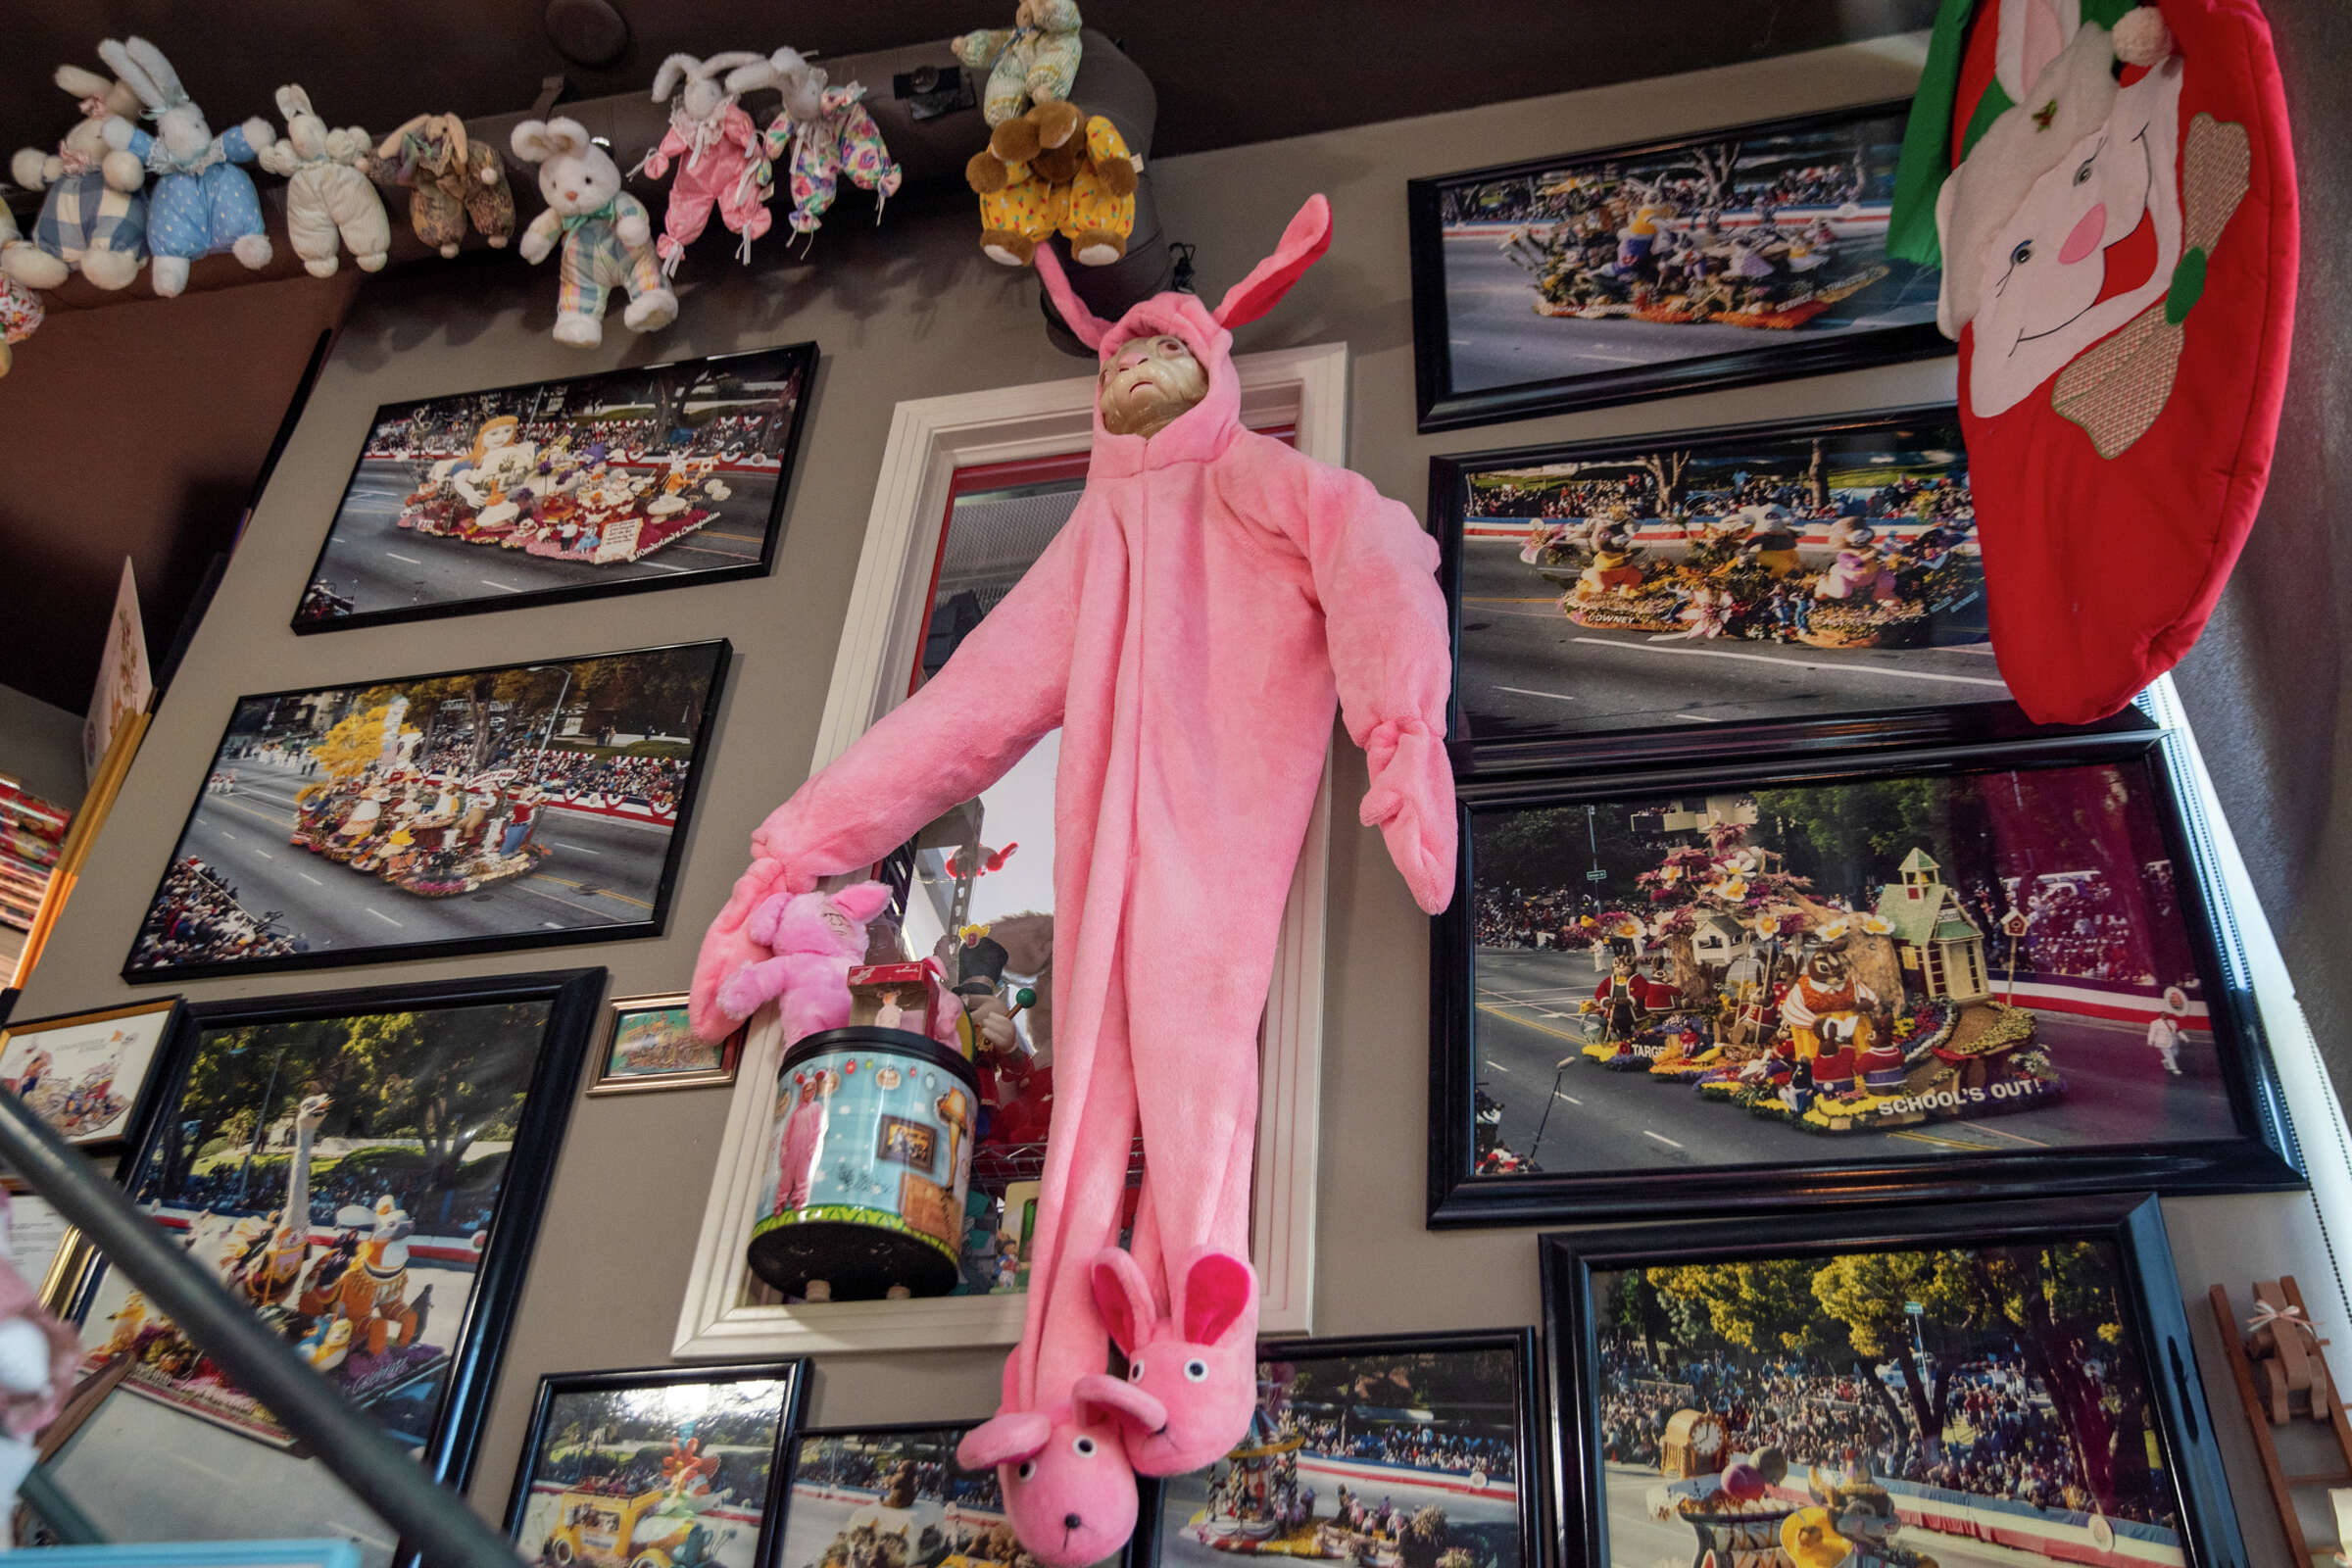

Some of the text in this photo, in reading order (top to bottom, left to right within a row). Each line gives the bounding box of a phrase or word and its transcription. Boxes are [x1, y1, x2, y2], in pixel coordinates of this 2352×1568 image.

[1631, 1043, 1669, 1057] TARGE
[1877, 1078, 2043, 1115] SCHOOL'S OUT!
